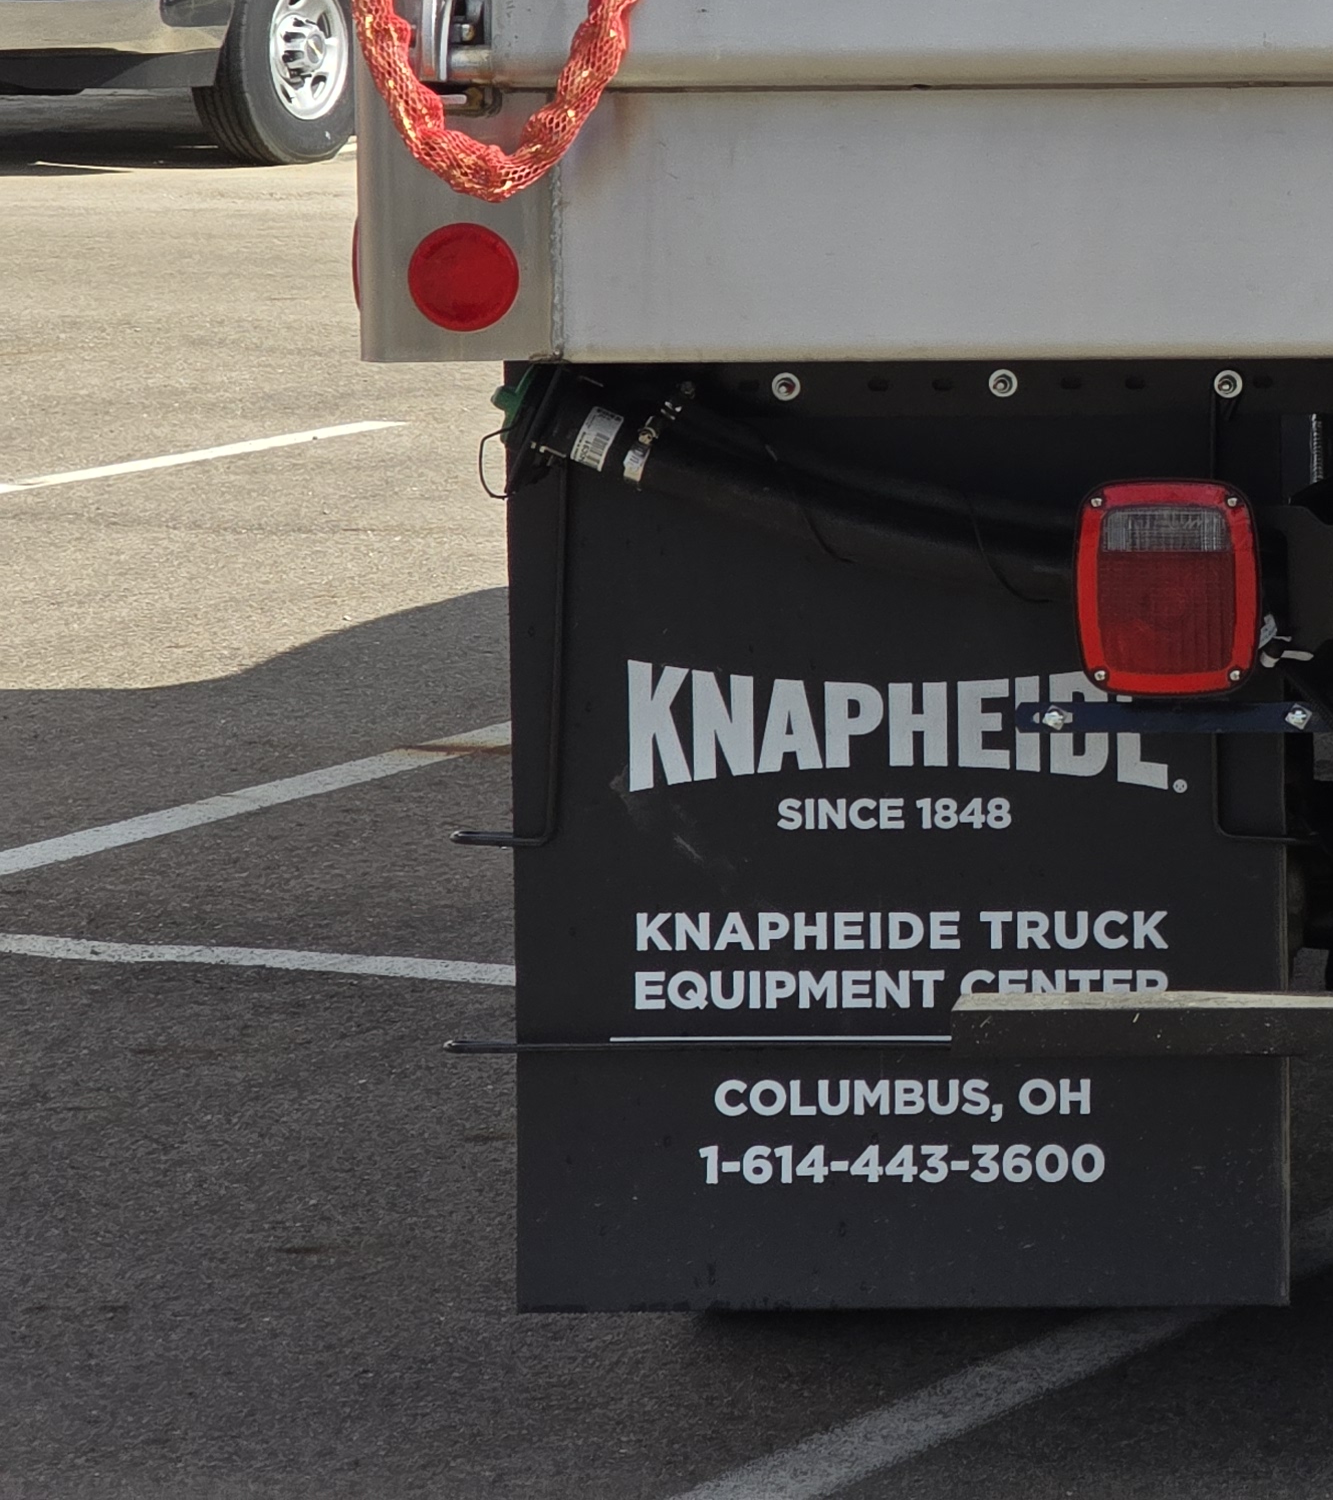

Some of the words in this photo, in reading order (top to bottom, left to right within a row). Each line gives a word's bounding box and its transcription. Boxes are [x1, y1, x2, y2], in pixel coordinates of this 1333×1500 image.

[777, 798, 904, 830] SINCE
[916, 798, 1012, 830] 1848
[636, 911, 961, 950] KNAPHEIDE
[980, 911, 1169, 950] TRUCK
[634, 970, 945, 1011] EQUIPMENT
[714, 1079, 1004, 1122] COLUMBUS,
[1018, 1079, 1091, 1115] OH
[698, 1143, 1105, 1185] 1-614-443-3600
